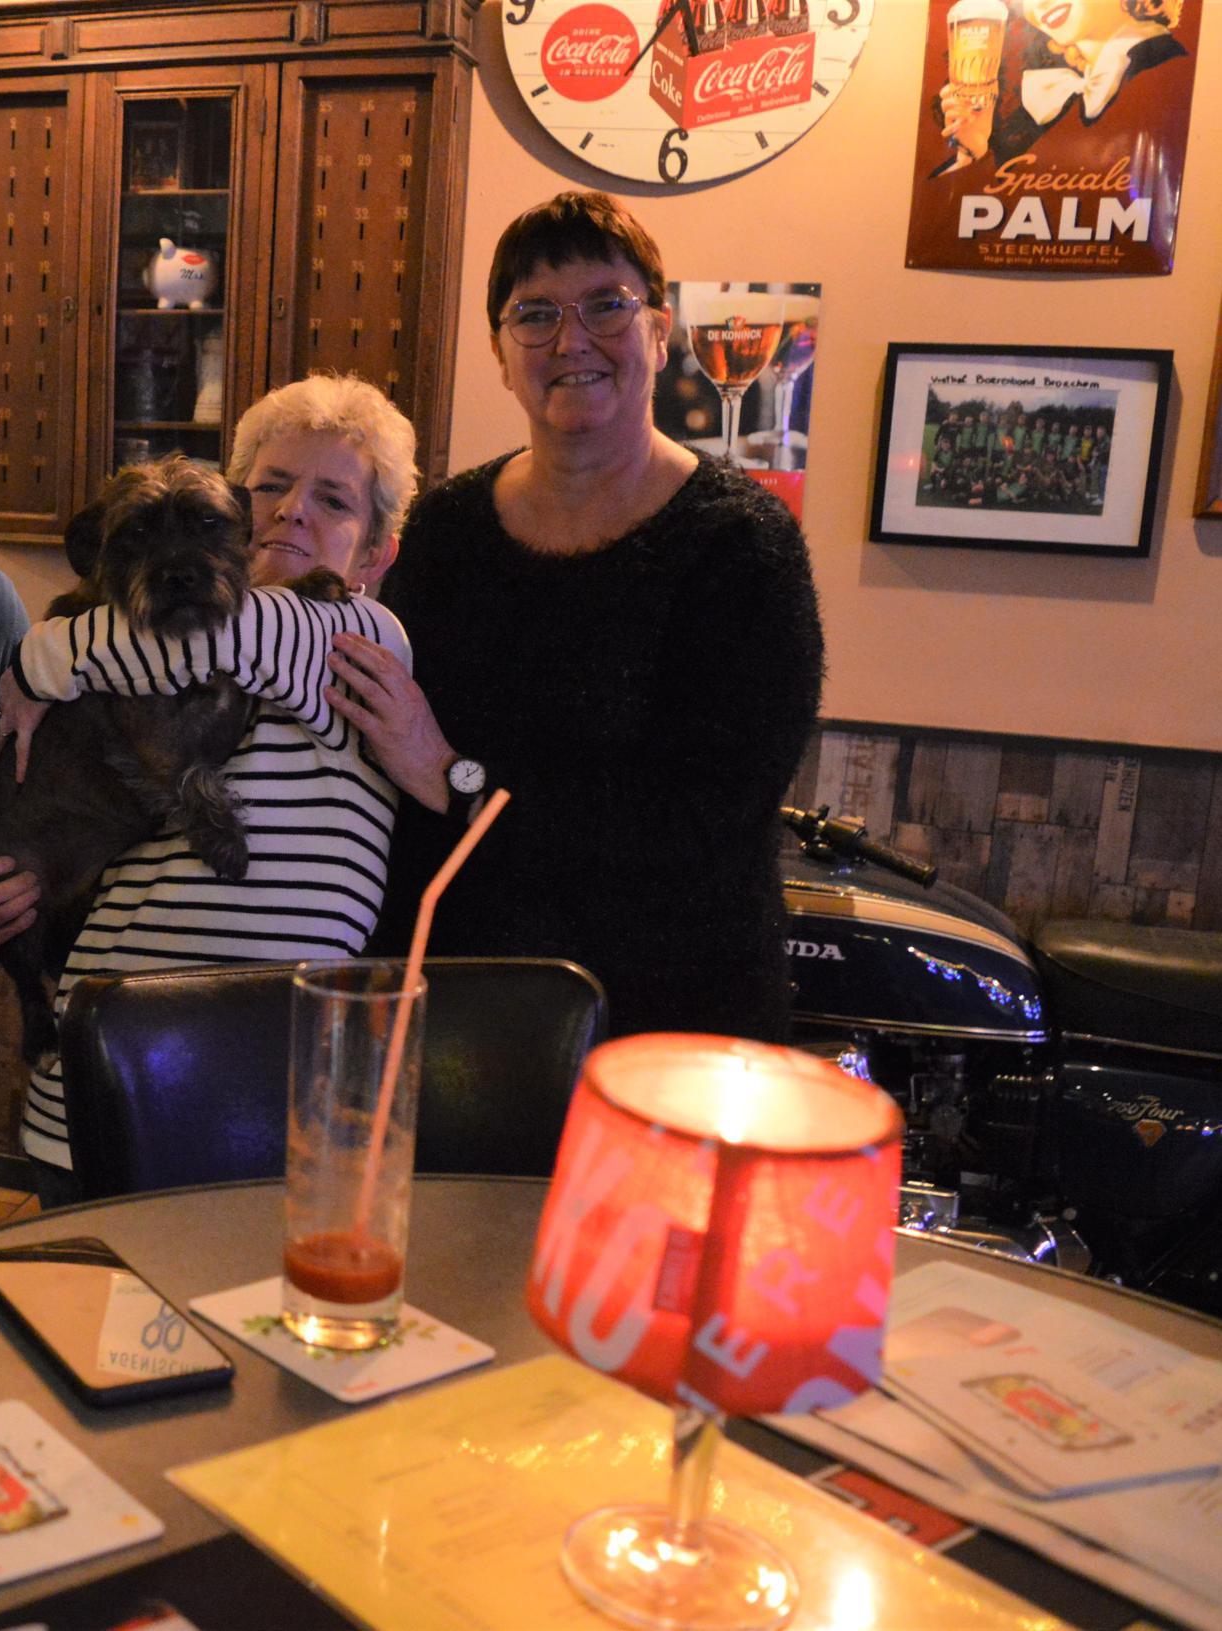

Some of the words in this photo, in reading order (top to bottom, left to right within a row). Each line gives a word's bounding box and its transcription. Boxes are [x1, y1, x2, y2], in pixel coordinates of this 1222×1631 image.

[651, 60, 683, 107] Coke
[657, 127, 689, 184] 6
[958, 195, 1152, 242] PALM
[979, 243, 1125, 256] STEENHUFFEL
[707, 329, 720, 341] DE
[721, 329, 762, 340] KONINCK
